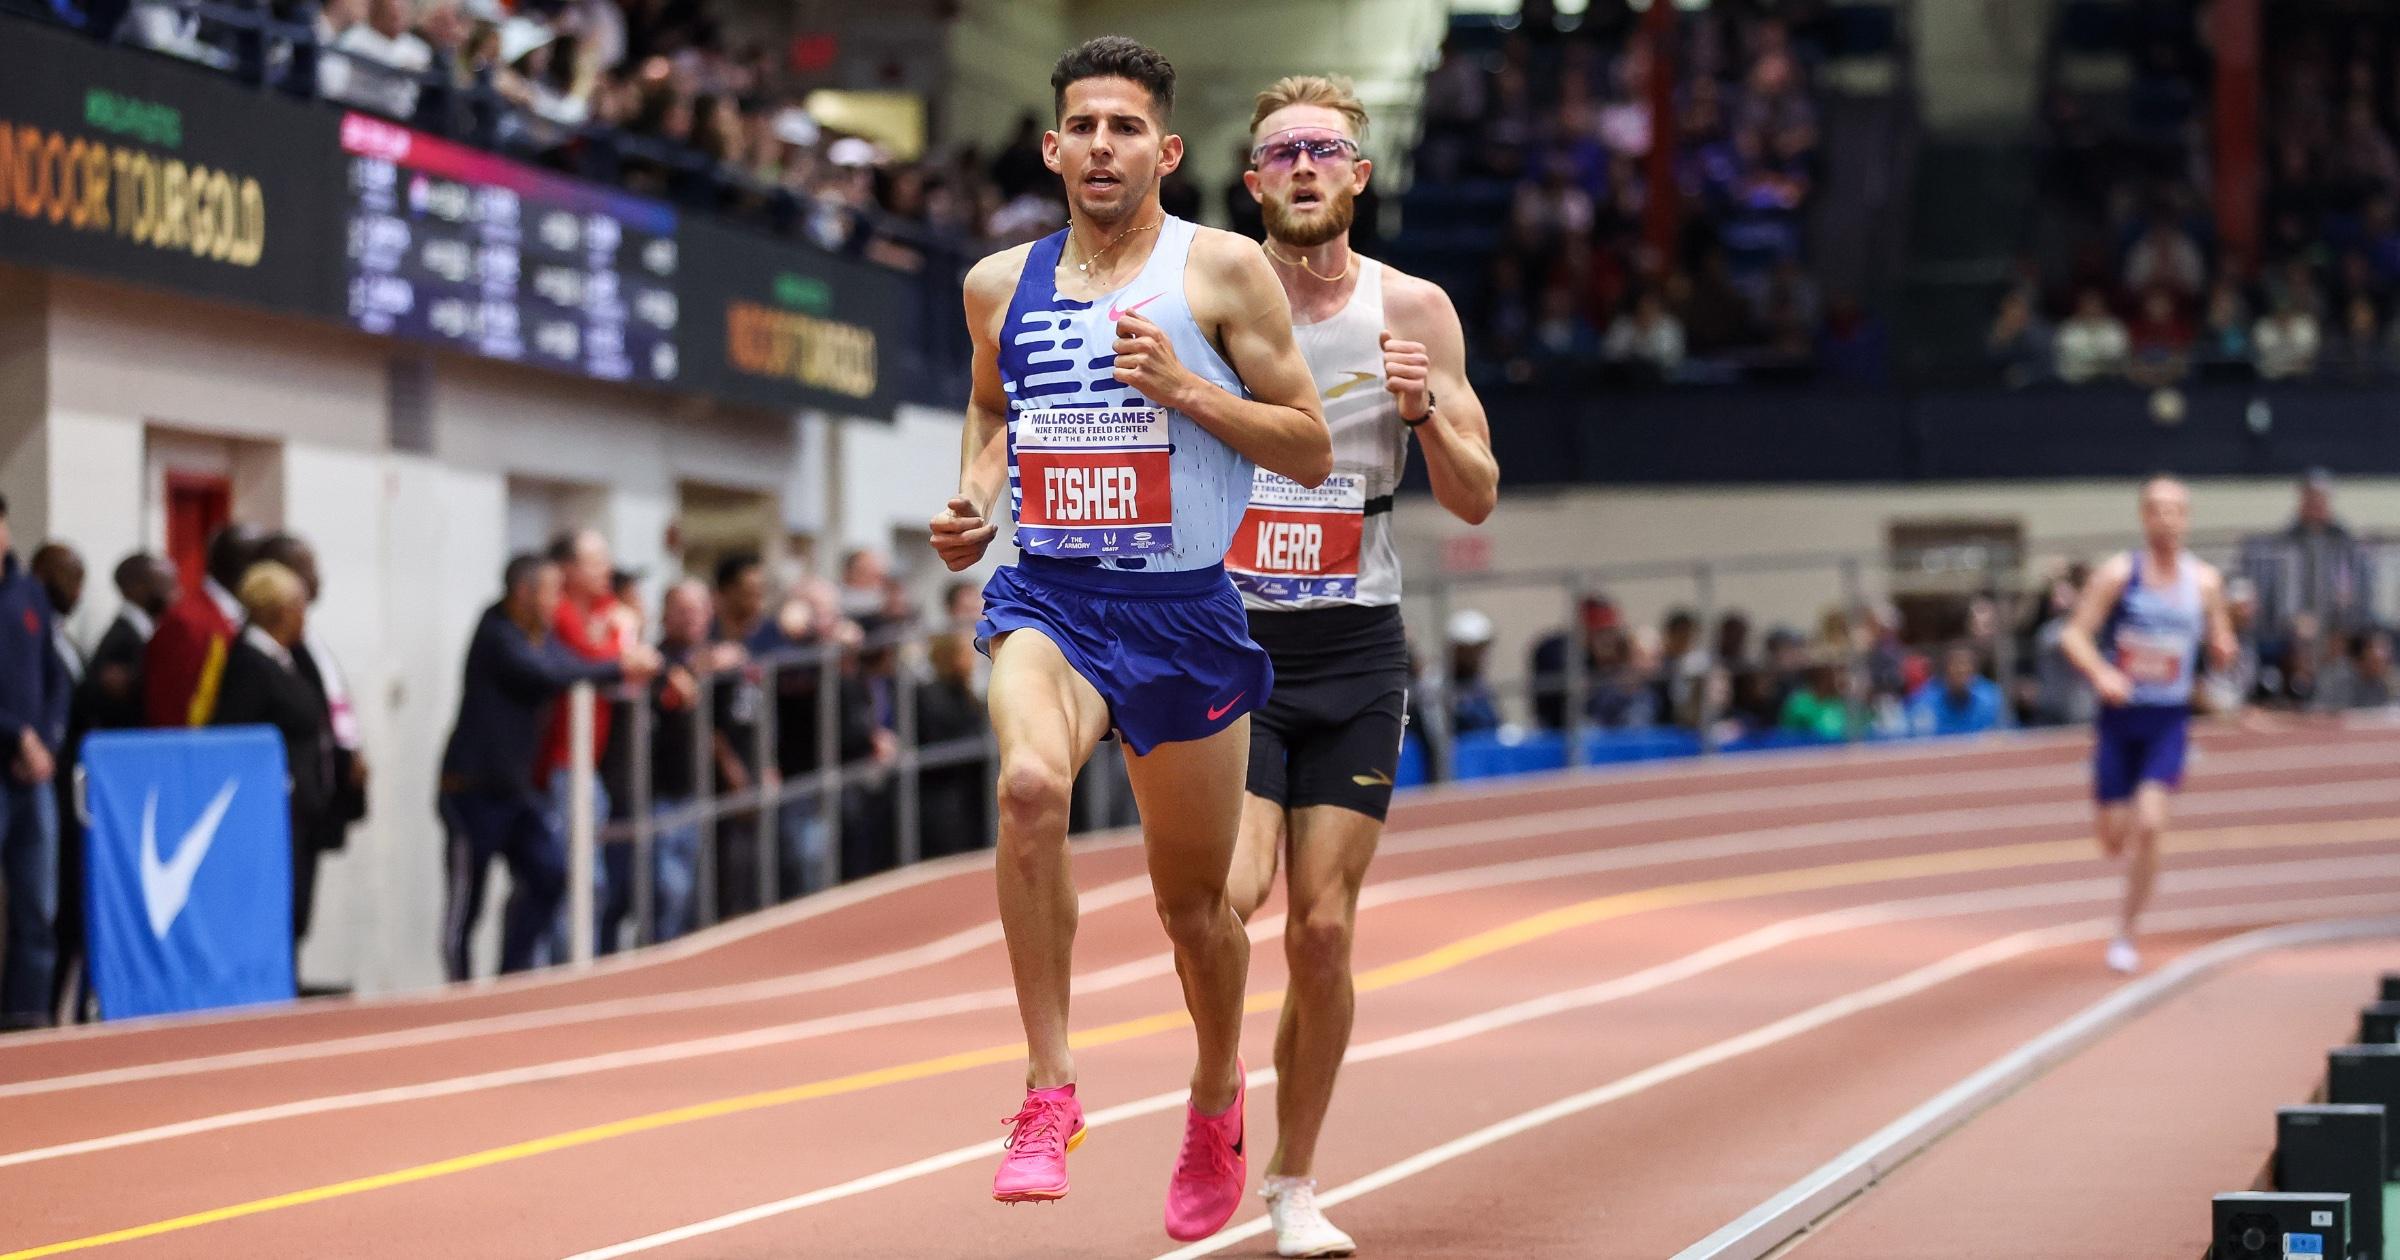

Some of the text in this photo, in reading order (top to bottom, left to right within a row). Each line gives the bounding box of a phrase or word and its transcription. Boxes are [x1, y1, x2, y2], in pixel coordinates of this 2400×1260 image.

[113, 147, 190, 249] TOUR
[189, 164, 265, 268] GOLD
[1031, 412, 1156, 425] MILLROSE GAMES
[1035, 425, 1148, 434] NIKE TRACK & FIELD CENTER
[1043, 466, 1138, 520] FISHER
[1255, 521, 1323, 571] KERR
